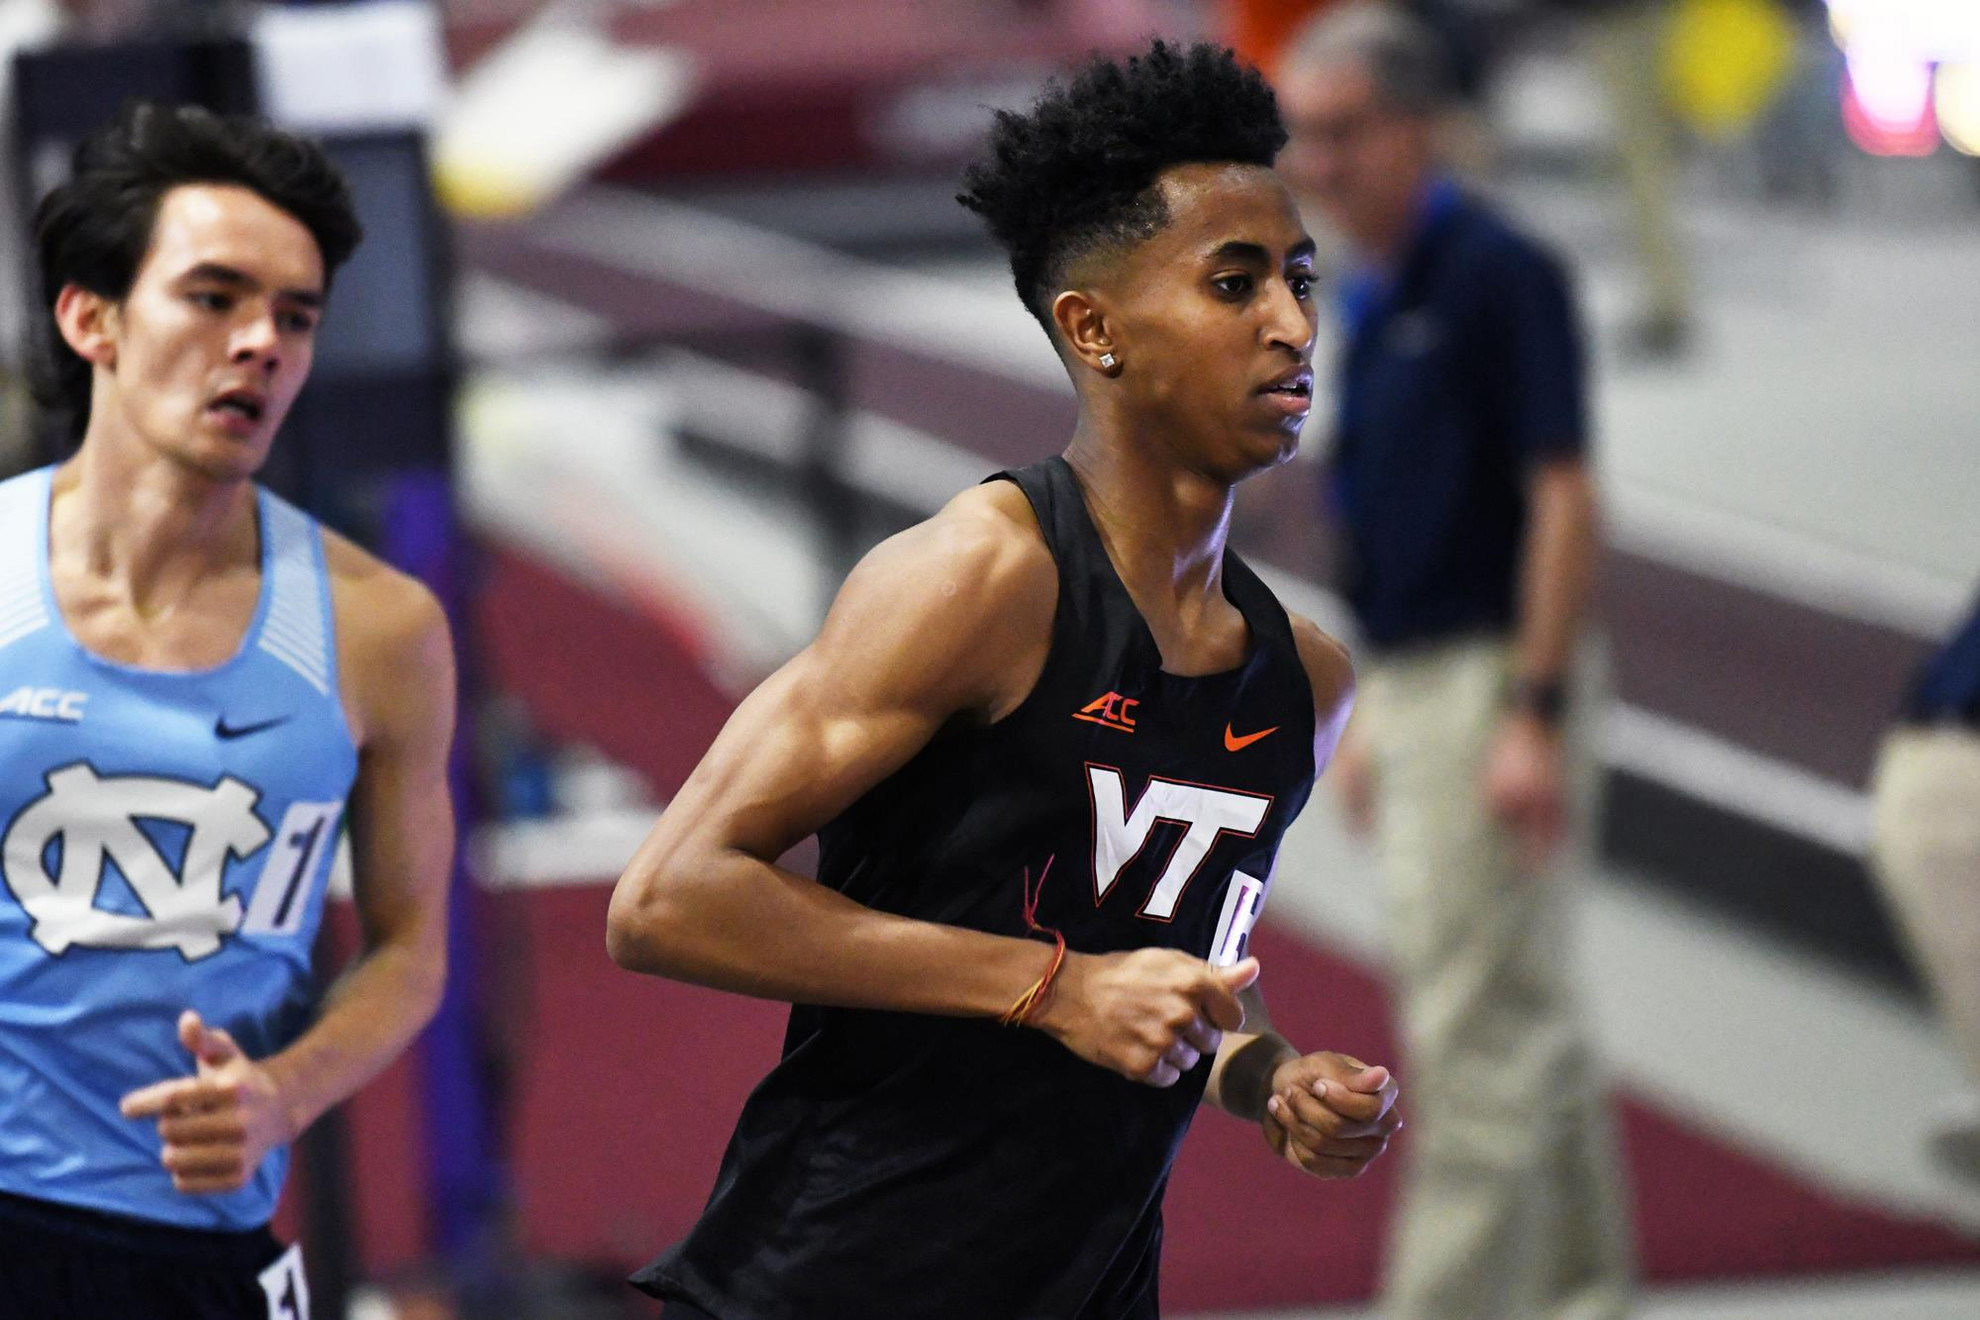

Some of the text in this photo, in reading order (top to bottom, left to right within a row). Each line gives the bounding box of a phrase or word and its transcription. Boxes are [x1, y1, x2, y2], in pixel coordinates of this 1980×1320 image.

[0, 685, 87, 720] ACC
[1080, 691, 1140, 726] ACC
[272, 814, 326, 928] 1
[1084, 760, 1275, 924] VT
